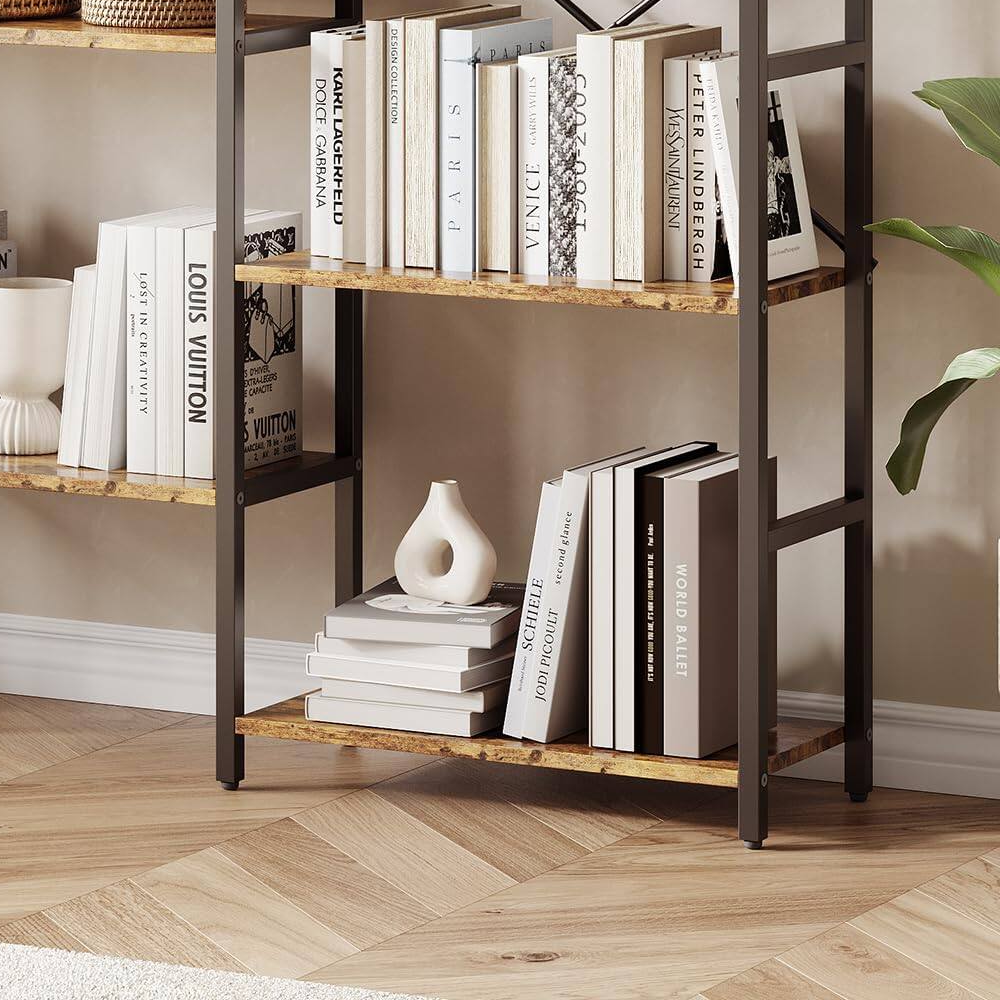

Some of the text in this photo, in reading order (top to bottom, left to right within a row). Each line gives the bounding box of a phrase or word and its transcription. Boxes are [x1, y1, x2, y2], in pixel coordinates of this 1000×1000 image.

[315, 78, 327, 124] DOLCE
[391, 65, 399, 124] COLLECTION
[490, 40, 546, 62] PARIS
[315, 134, 328, 208] GABBANA
[332, 67, 344, 226] KARL LAGERFELD
[447, 104, 462, 232] PARIS
[525, 76, 541, 250] VENICE GARRY WILLS
[692, 74, 705, 270] PETER LINDBERGH
[137, 272, 150, 415] LOST IN CREATIVITY
[188, 263, 207, 424] LOUIS VUITTON
[254, 408, 296, 440] VUITTON
[521, 578, 544, 651] SCHIELE
[534, 510, 573, 702] JODI PICOULT second glance
[675, 563, 688, 677] WORLD BALLET
